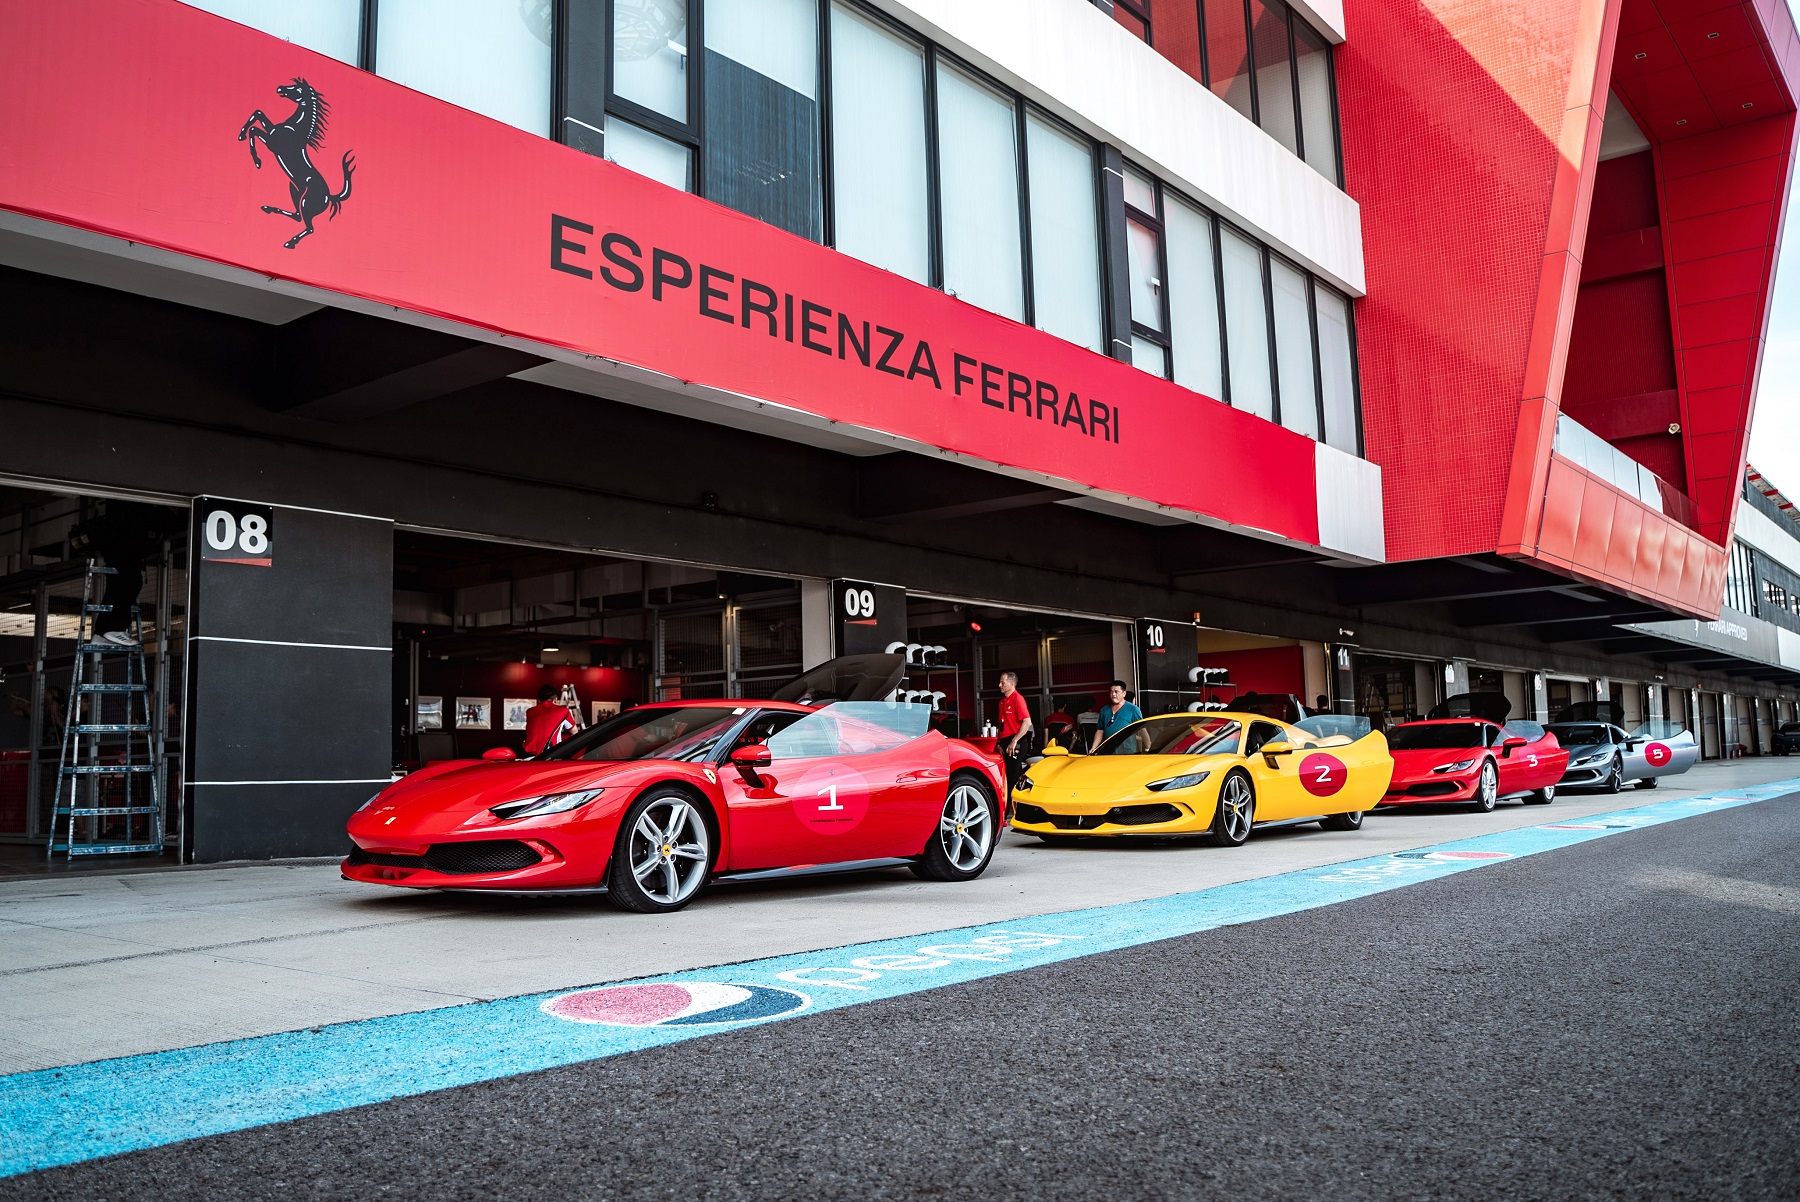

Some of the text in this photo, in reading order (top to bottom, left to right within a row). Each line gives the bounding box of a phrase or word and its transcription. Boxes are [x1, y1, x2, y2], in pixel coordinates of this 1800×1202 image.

[550, 213, 1119, 444] ESPERIENZA FERRARI
[206, 510, 268, 554] 08
[845, 588, 875, 617] 09
[1146, 625, 1163, 647] 10
[1726, 621, 1748, 641] APPROVED
[1337, 648, 1348, 666] 11
[1526, 754, 1539, 767] 3
[1652, 748, 1664, 759] 5
[1314, 765, 1332, 783] 2
[817, 784, 844, 811] 1
[775, 930, 1087, 991] pepsi
